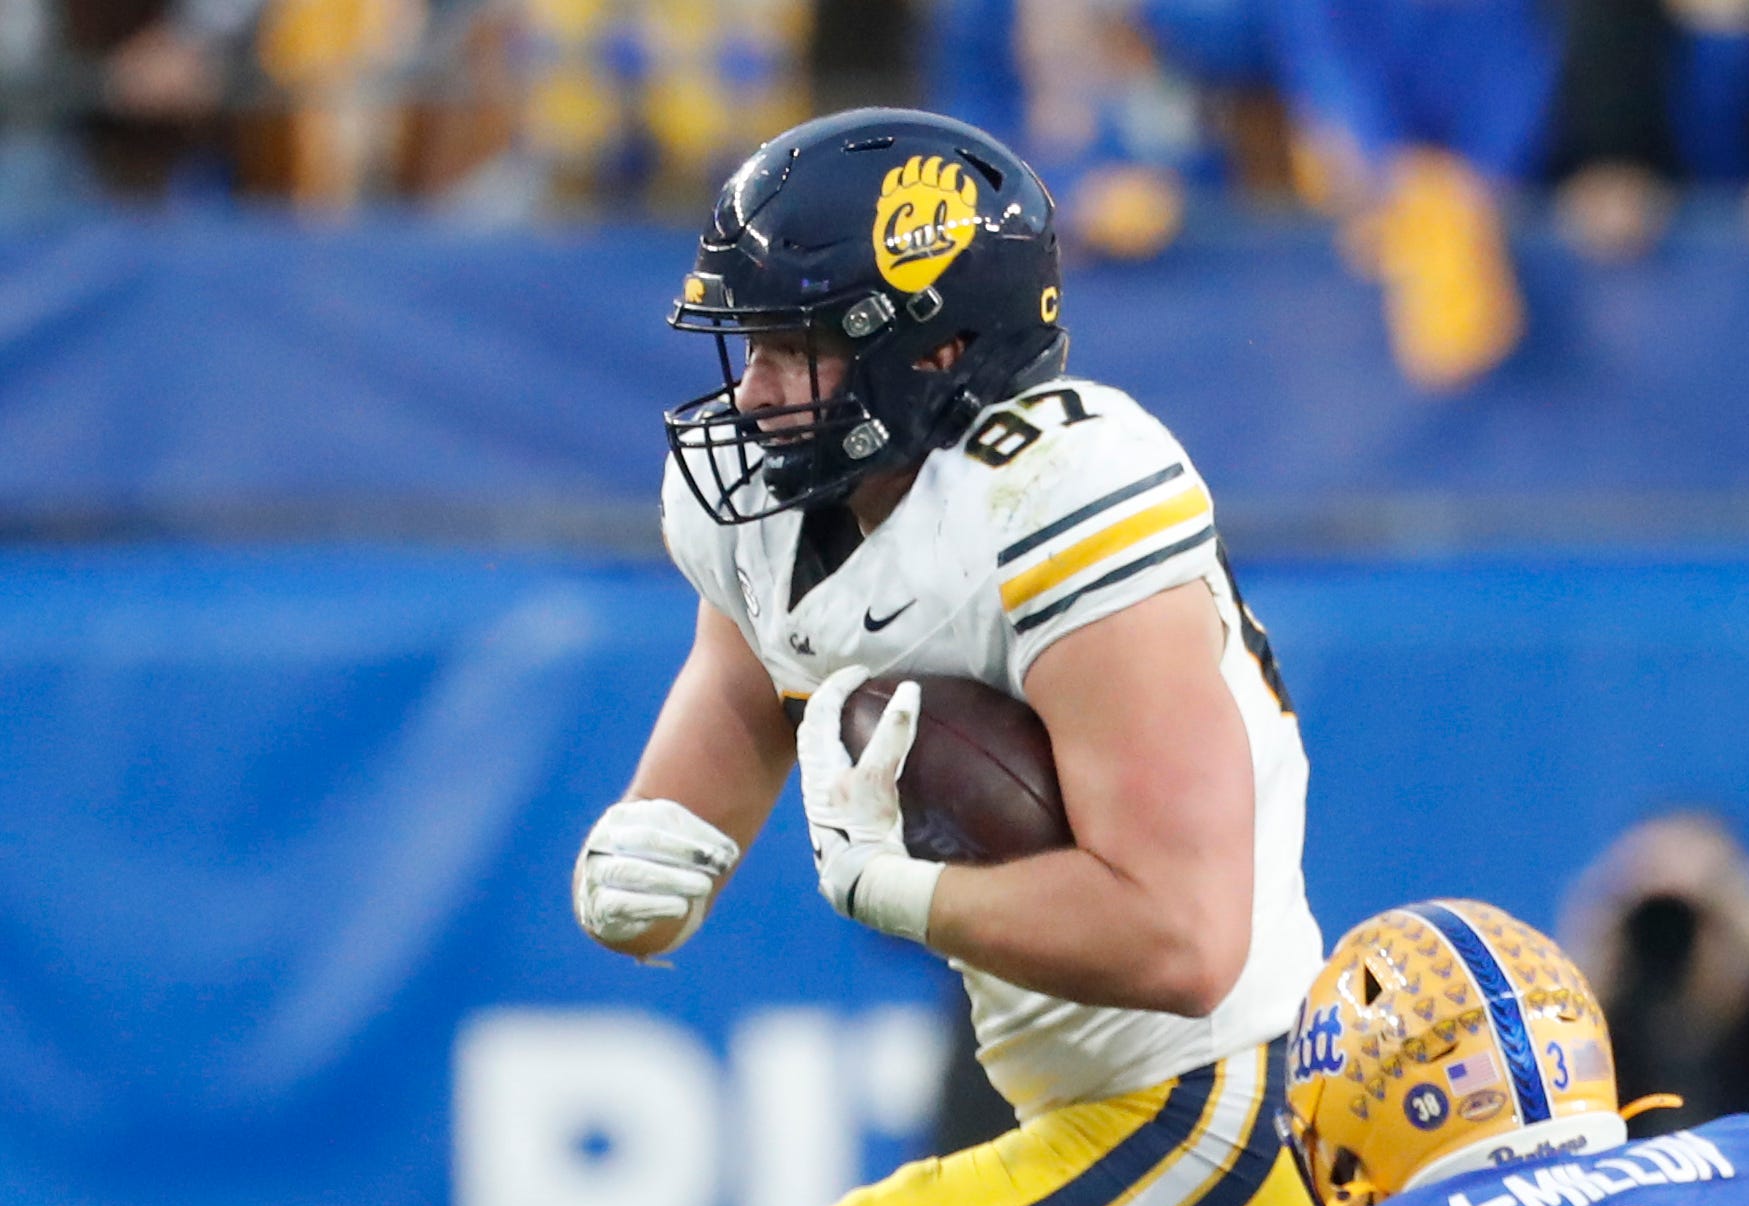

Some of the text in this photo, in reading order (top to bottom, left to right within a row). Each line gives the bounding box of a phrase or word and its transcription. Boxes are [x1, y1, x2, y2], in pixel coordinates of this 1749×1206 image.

[883, 199, 956, 270] Cal
[964, 388, 1104, 469] 87
[1290, 997, 1344, 1079] itt
[1547, 1040, 1569, 1090] 3
